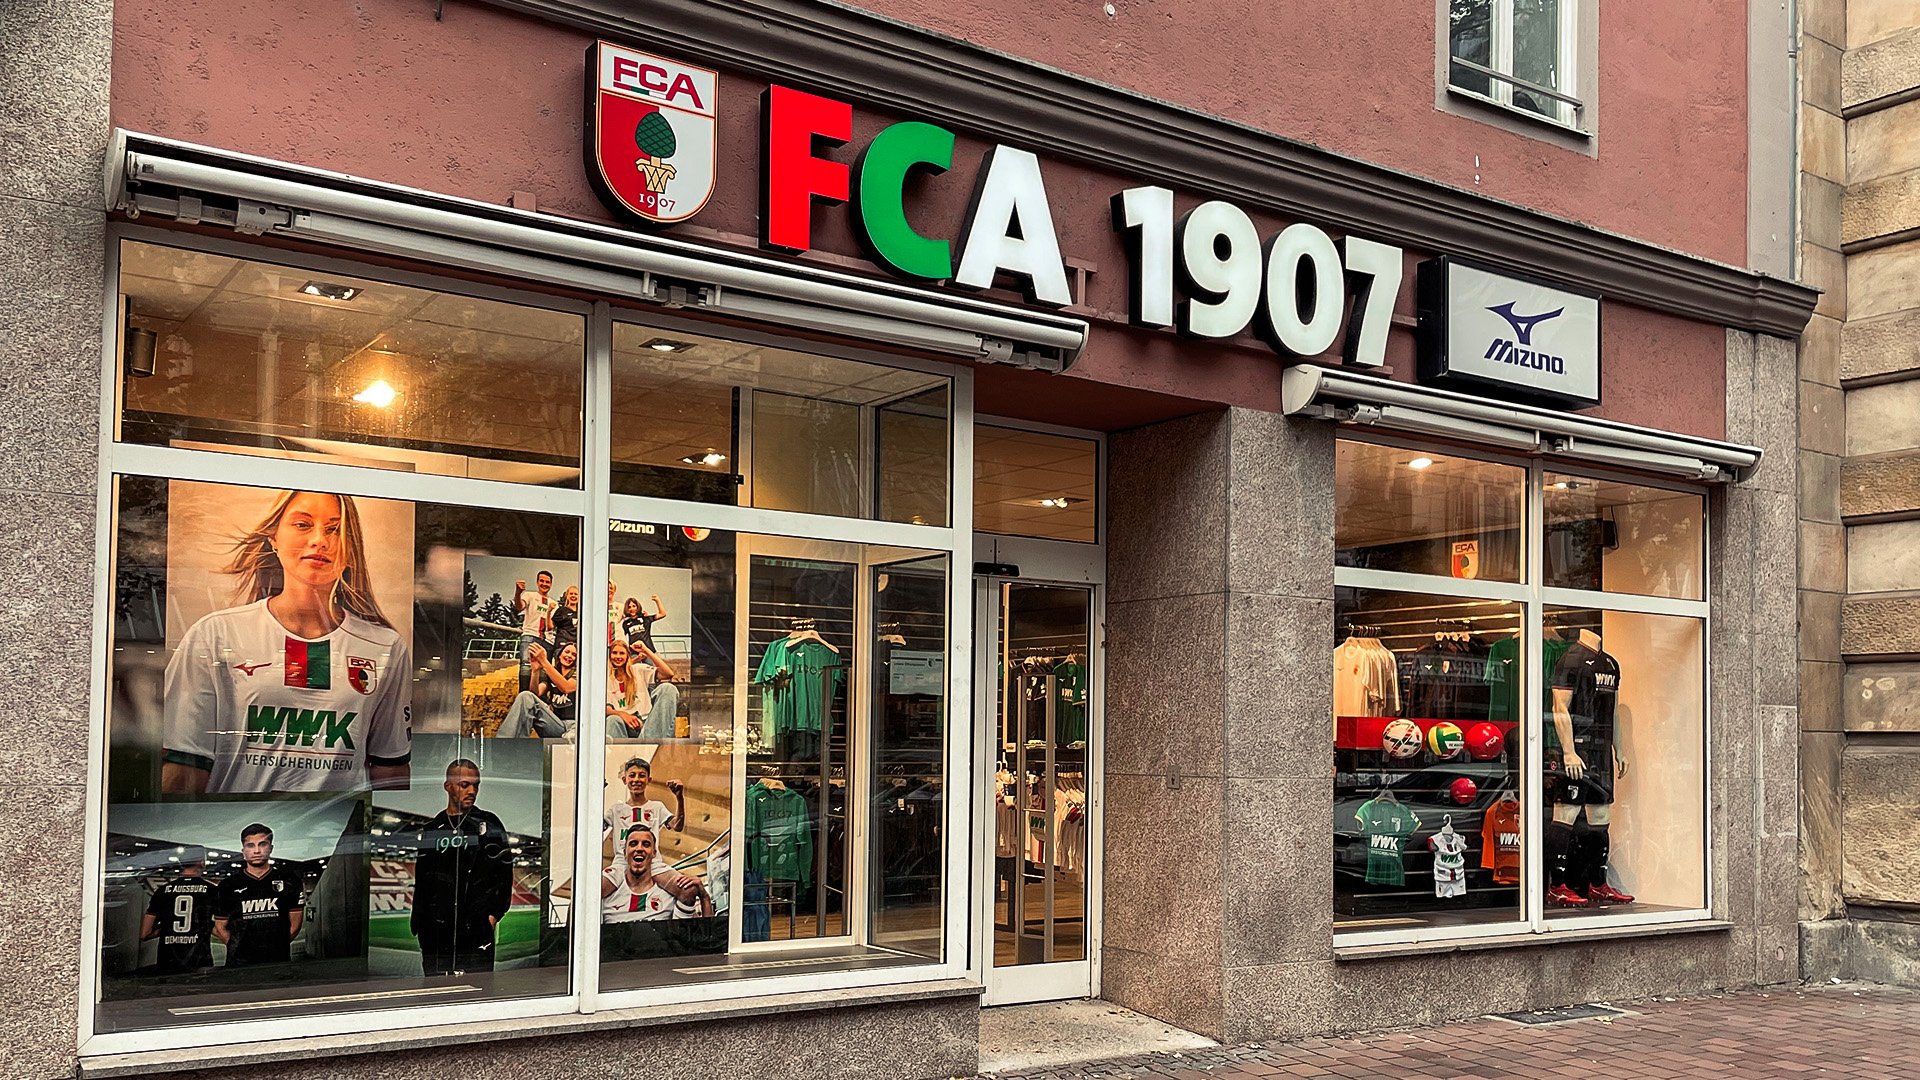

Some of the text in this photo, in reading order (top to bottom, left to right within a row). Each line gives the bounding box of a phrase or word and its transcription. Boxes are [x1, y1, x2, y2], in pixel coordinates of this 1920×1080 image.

[612, 55, 704, 109] FCA
[639, 193, 676, 212] 1907
[768, 84, 1403, 367] FCA 1907
[1455, 543, 1475, 554] FCA
[246, 703, 359, 750] WWK
[245, 754, 354, 772] VERSICHERUNGEN
[1370, 834, 1398, 850] WWK
[173, 895, 194, 933] 9
[242, 897, 279, 914] WWK
